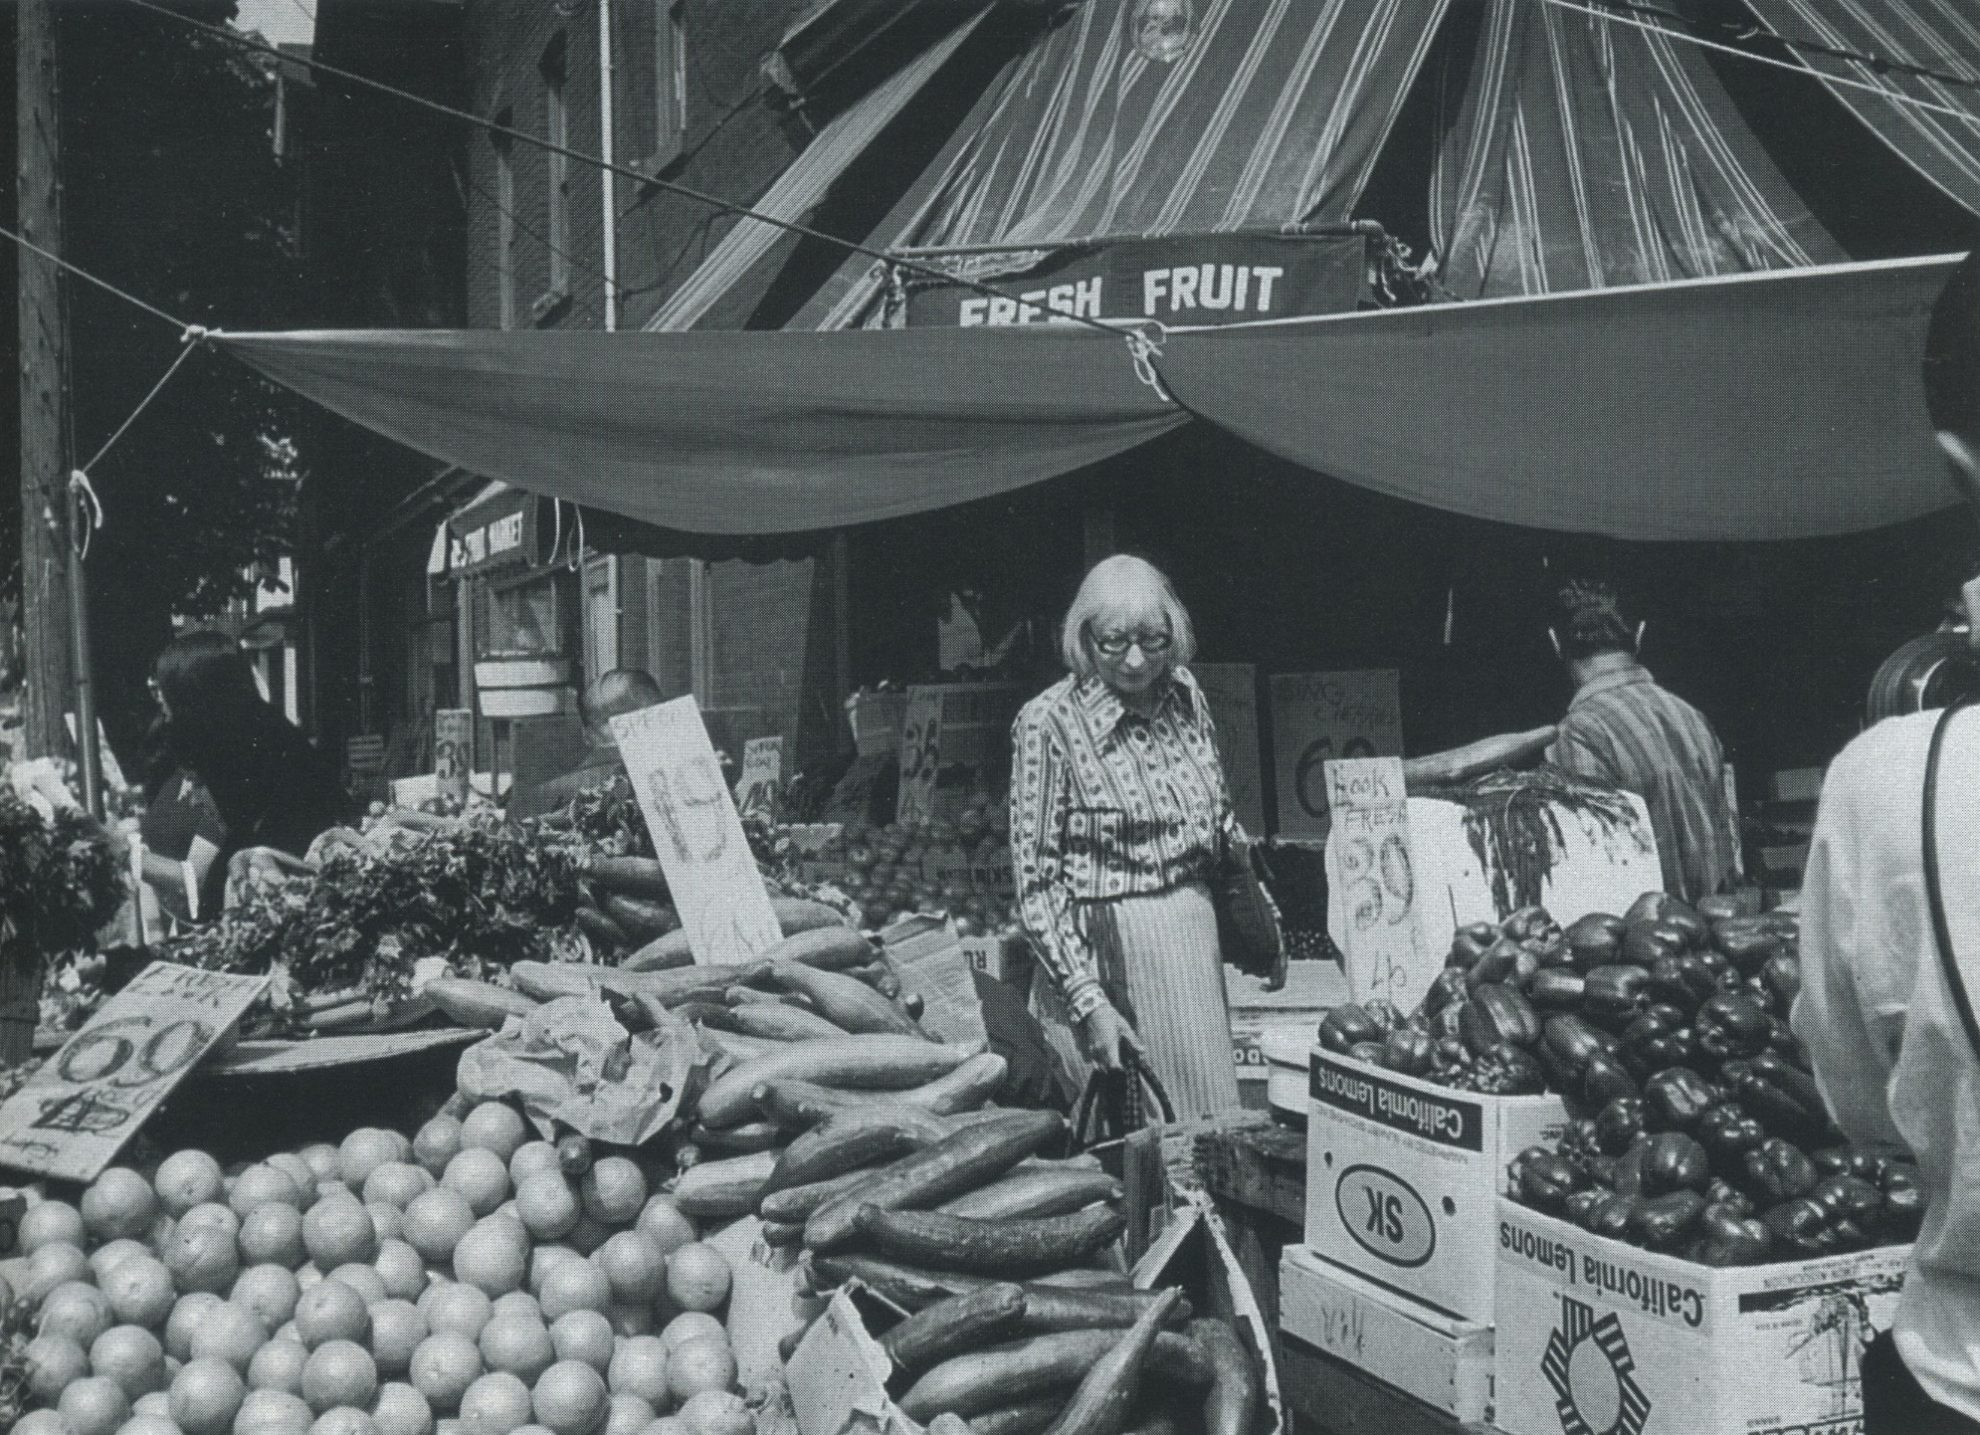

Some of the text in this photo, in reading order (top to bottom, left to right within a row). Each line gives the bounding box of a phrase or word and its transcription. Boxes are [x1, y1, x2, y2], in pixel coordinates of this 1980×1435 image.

[960, 264, 1283, 327] FRESH FRUIT
[1344, 802, 1407, 832] FRESH
[1343, 832, 1414, 931] 39
[57, 1015, 216, 1088] 69
[1318, 1066, 1375, 1109] Lemons
[1377, 1091, 1464, 1140] California
[1362, 1185, 1405, 1245] SK
[1499, 1219, 1704, 1328] California Lemons
